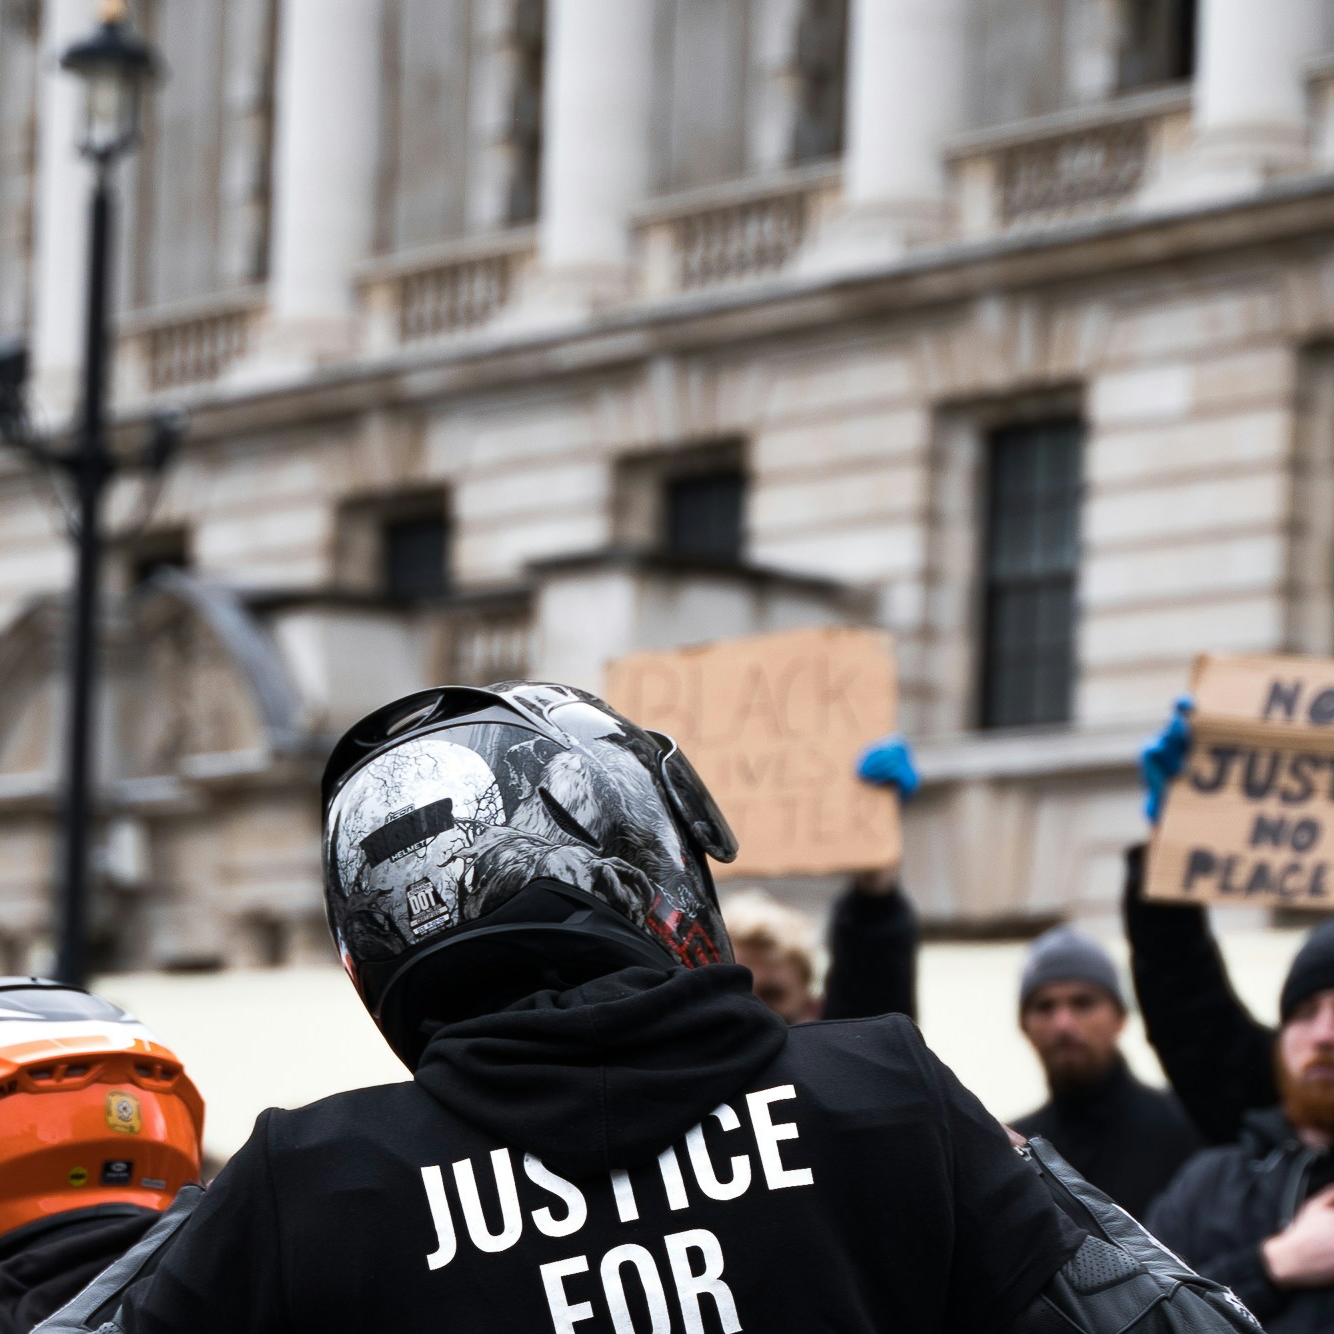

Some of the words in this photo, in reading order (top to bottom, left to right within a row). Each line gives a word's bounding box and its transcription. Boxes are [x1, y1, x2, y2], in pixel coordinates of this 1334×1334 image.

[1249, 812, 1321, 854] NO
[390, 840, 427, 862] HELMET
[1182, 847, 1334, 899] PEACE
[407, 887, 436, 915] DOT
